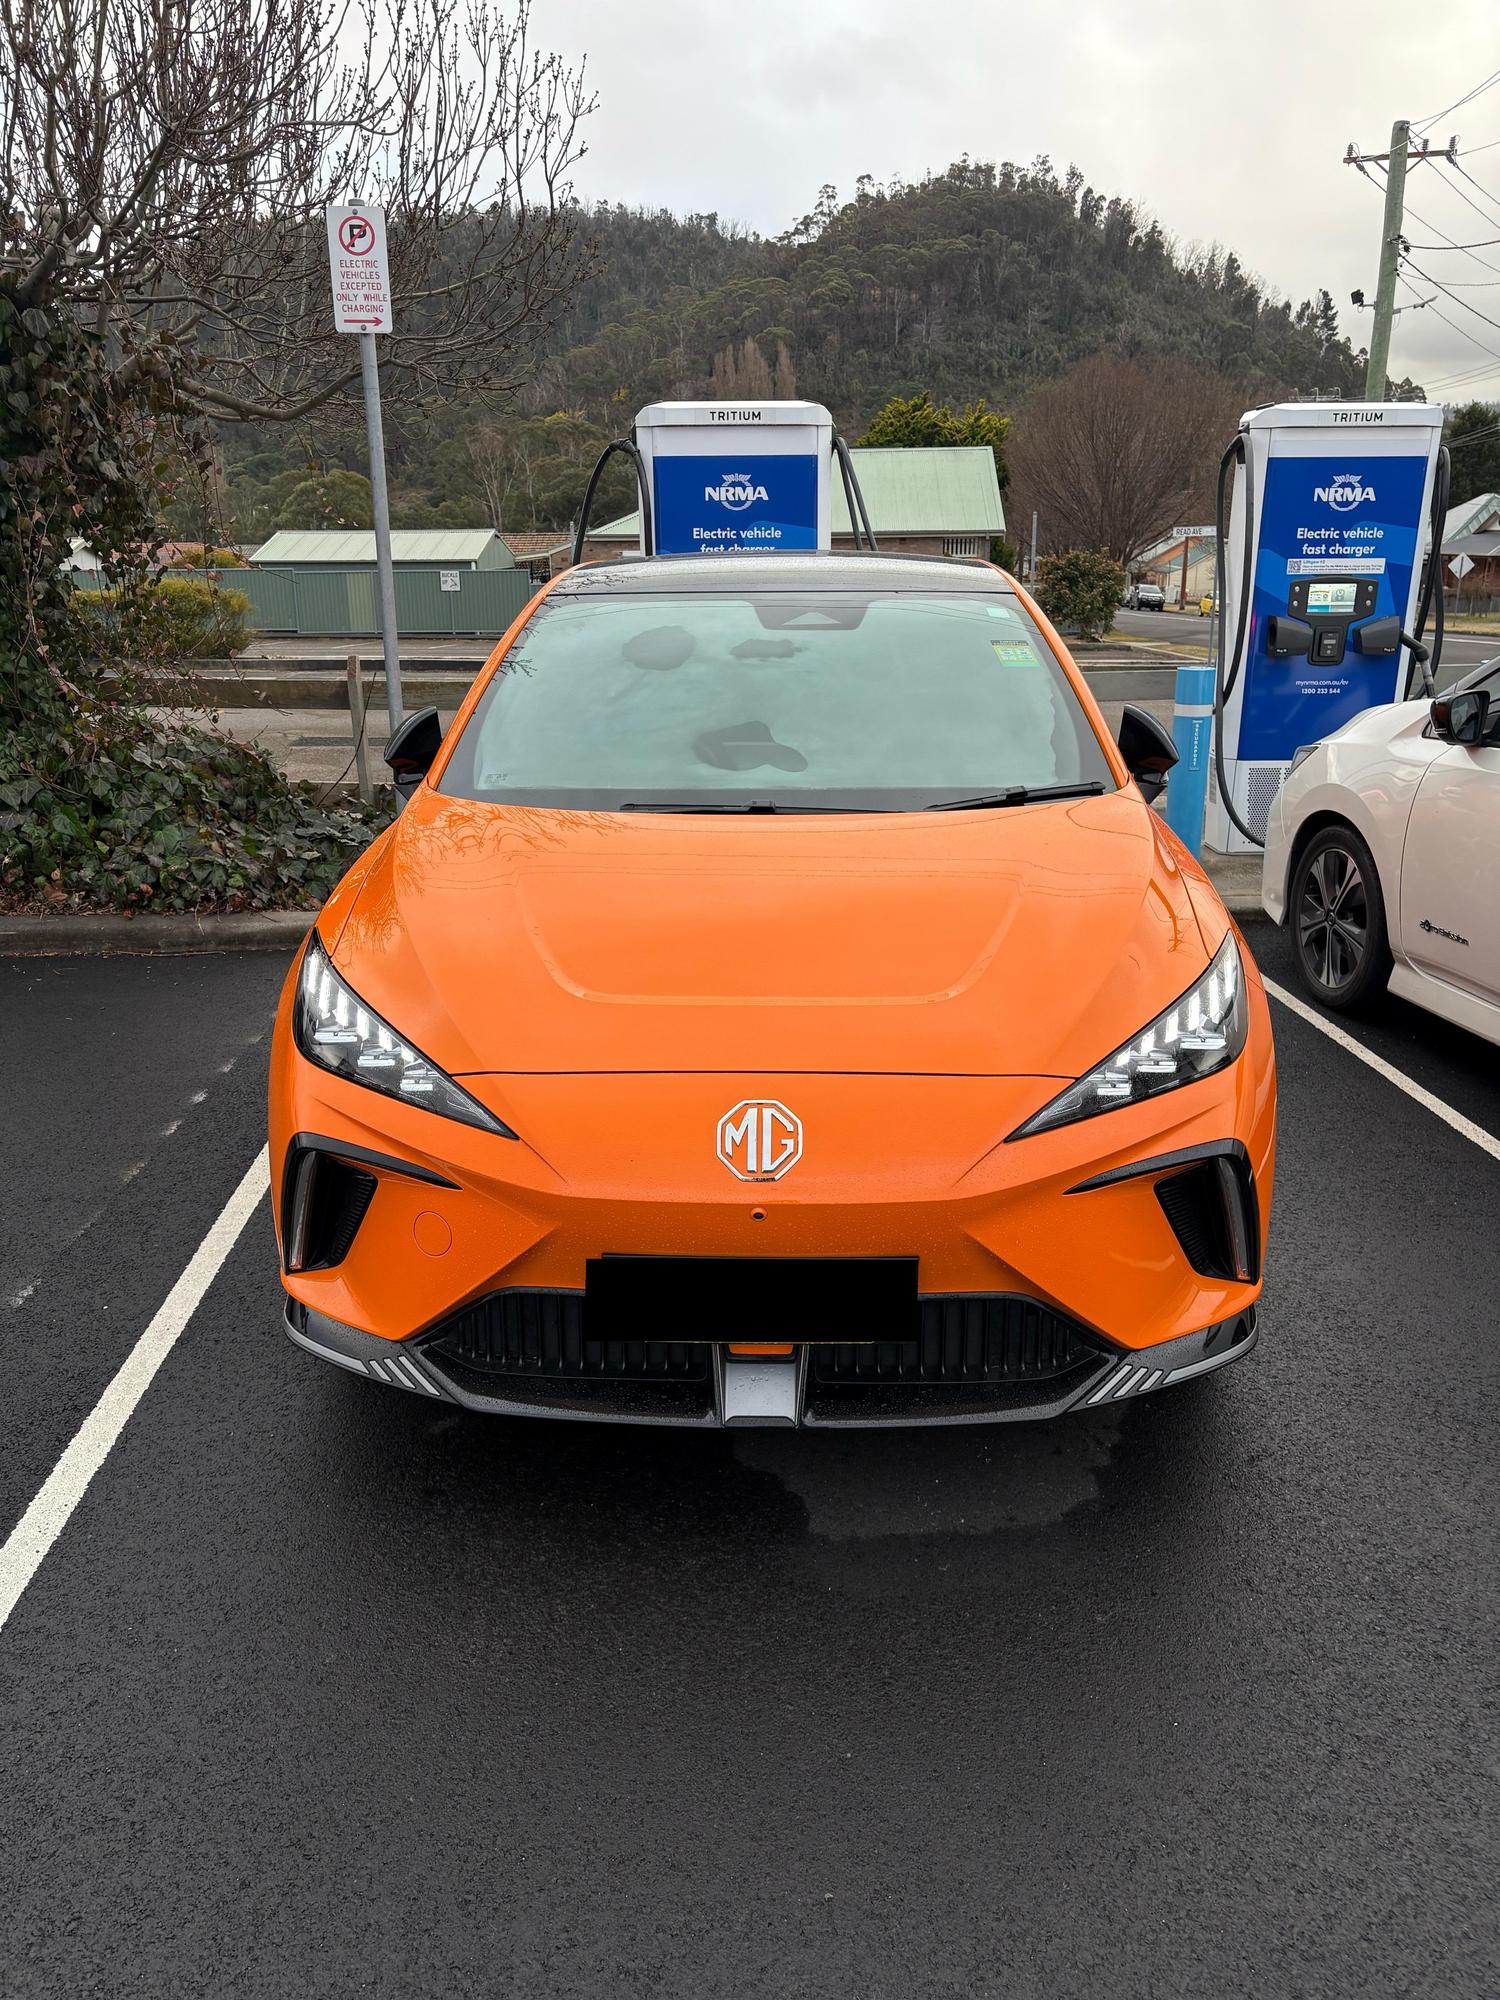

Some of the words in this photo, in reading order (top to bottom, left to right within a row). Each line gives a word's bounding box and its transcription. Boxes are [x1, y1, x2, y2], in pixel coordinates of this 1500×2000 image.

[339, 259, 379, 269] ELECTRIC
[340, 271, 380, 280] VEHICLES
[340, 282, 382, 291] EXCEPTED
[336, 293, 359, 302] ONLY
[363, 294, 388, 302] WHILE
[342, 304, 384, 313] CHARGING
[709, 411, 762, 421] TRITIUM
[1332, 412, 1384, 422] TRITIUM
[704, 486, 769, 501] NRMA
[1313, 487, 1376, 502] NRMA
[692, 527, 737, 539] Electric
[739, 527, 782, 539] vehicle
[1176, 527, 1191, 536] READ
[1191, 527, 1203, 536] AVE
[1296, 527, 1340, 540] Electric
[1343, 527, 1384, 539] vehicle
[1302, 543, 1326, 555] fast
[1328, 543, 1376, 557] charger
[1295, 678, 1349, 687] mynrma.com.au/ev
[724, 1107, 795, 1174] MG
